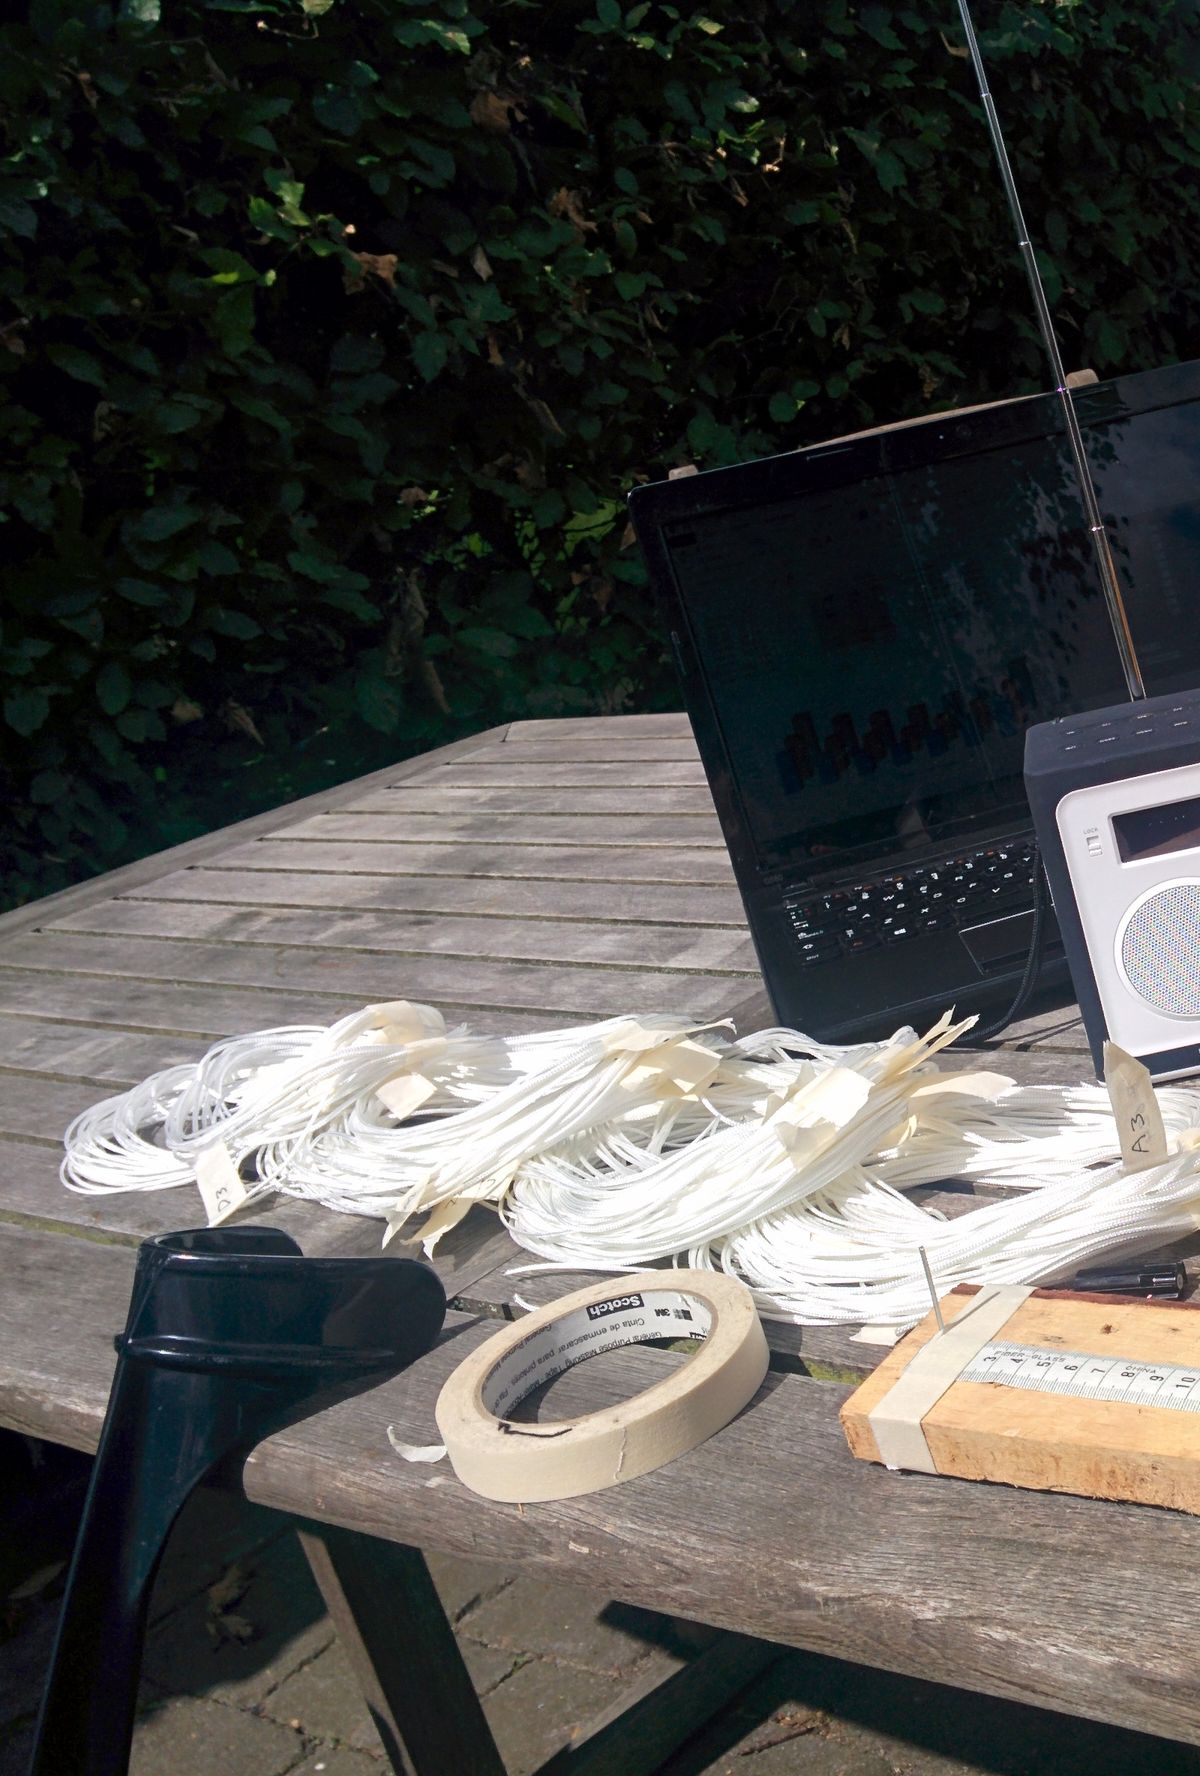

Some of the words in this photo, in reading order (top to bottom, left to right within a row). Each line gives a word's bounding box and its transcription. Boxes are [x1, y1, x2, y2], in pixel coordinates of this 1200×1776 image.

[1083, 827, 1099, 835] LOCK
[588, 1295, 641, 1319] Scotch
[654, 1308, 671, 1318] 3M
[608, 1321, 621, 1332] de
[621, 1317, 645, 1329] Cinta
[557, 1326, 608, 1353] enmascarar
[633, 1331, 663, 1342] General
[600, 1337, 633, 1353] Purpose
[537, 1348, 556, 1365] para
[564, 1346, 601, 1367] Masking
[1010, 1357, 1024, 1365] 4
[1063, 1364, 1079, 1372] 6
[1149, 1374, 1165, 1382] 9
[1175, 1376, 1196, 1390] 10
[1125, 1364, 1157, 1375] CHINA
